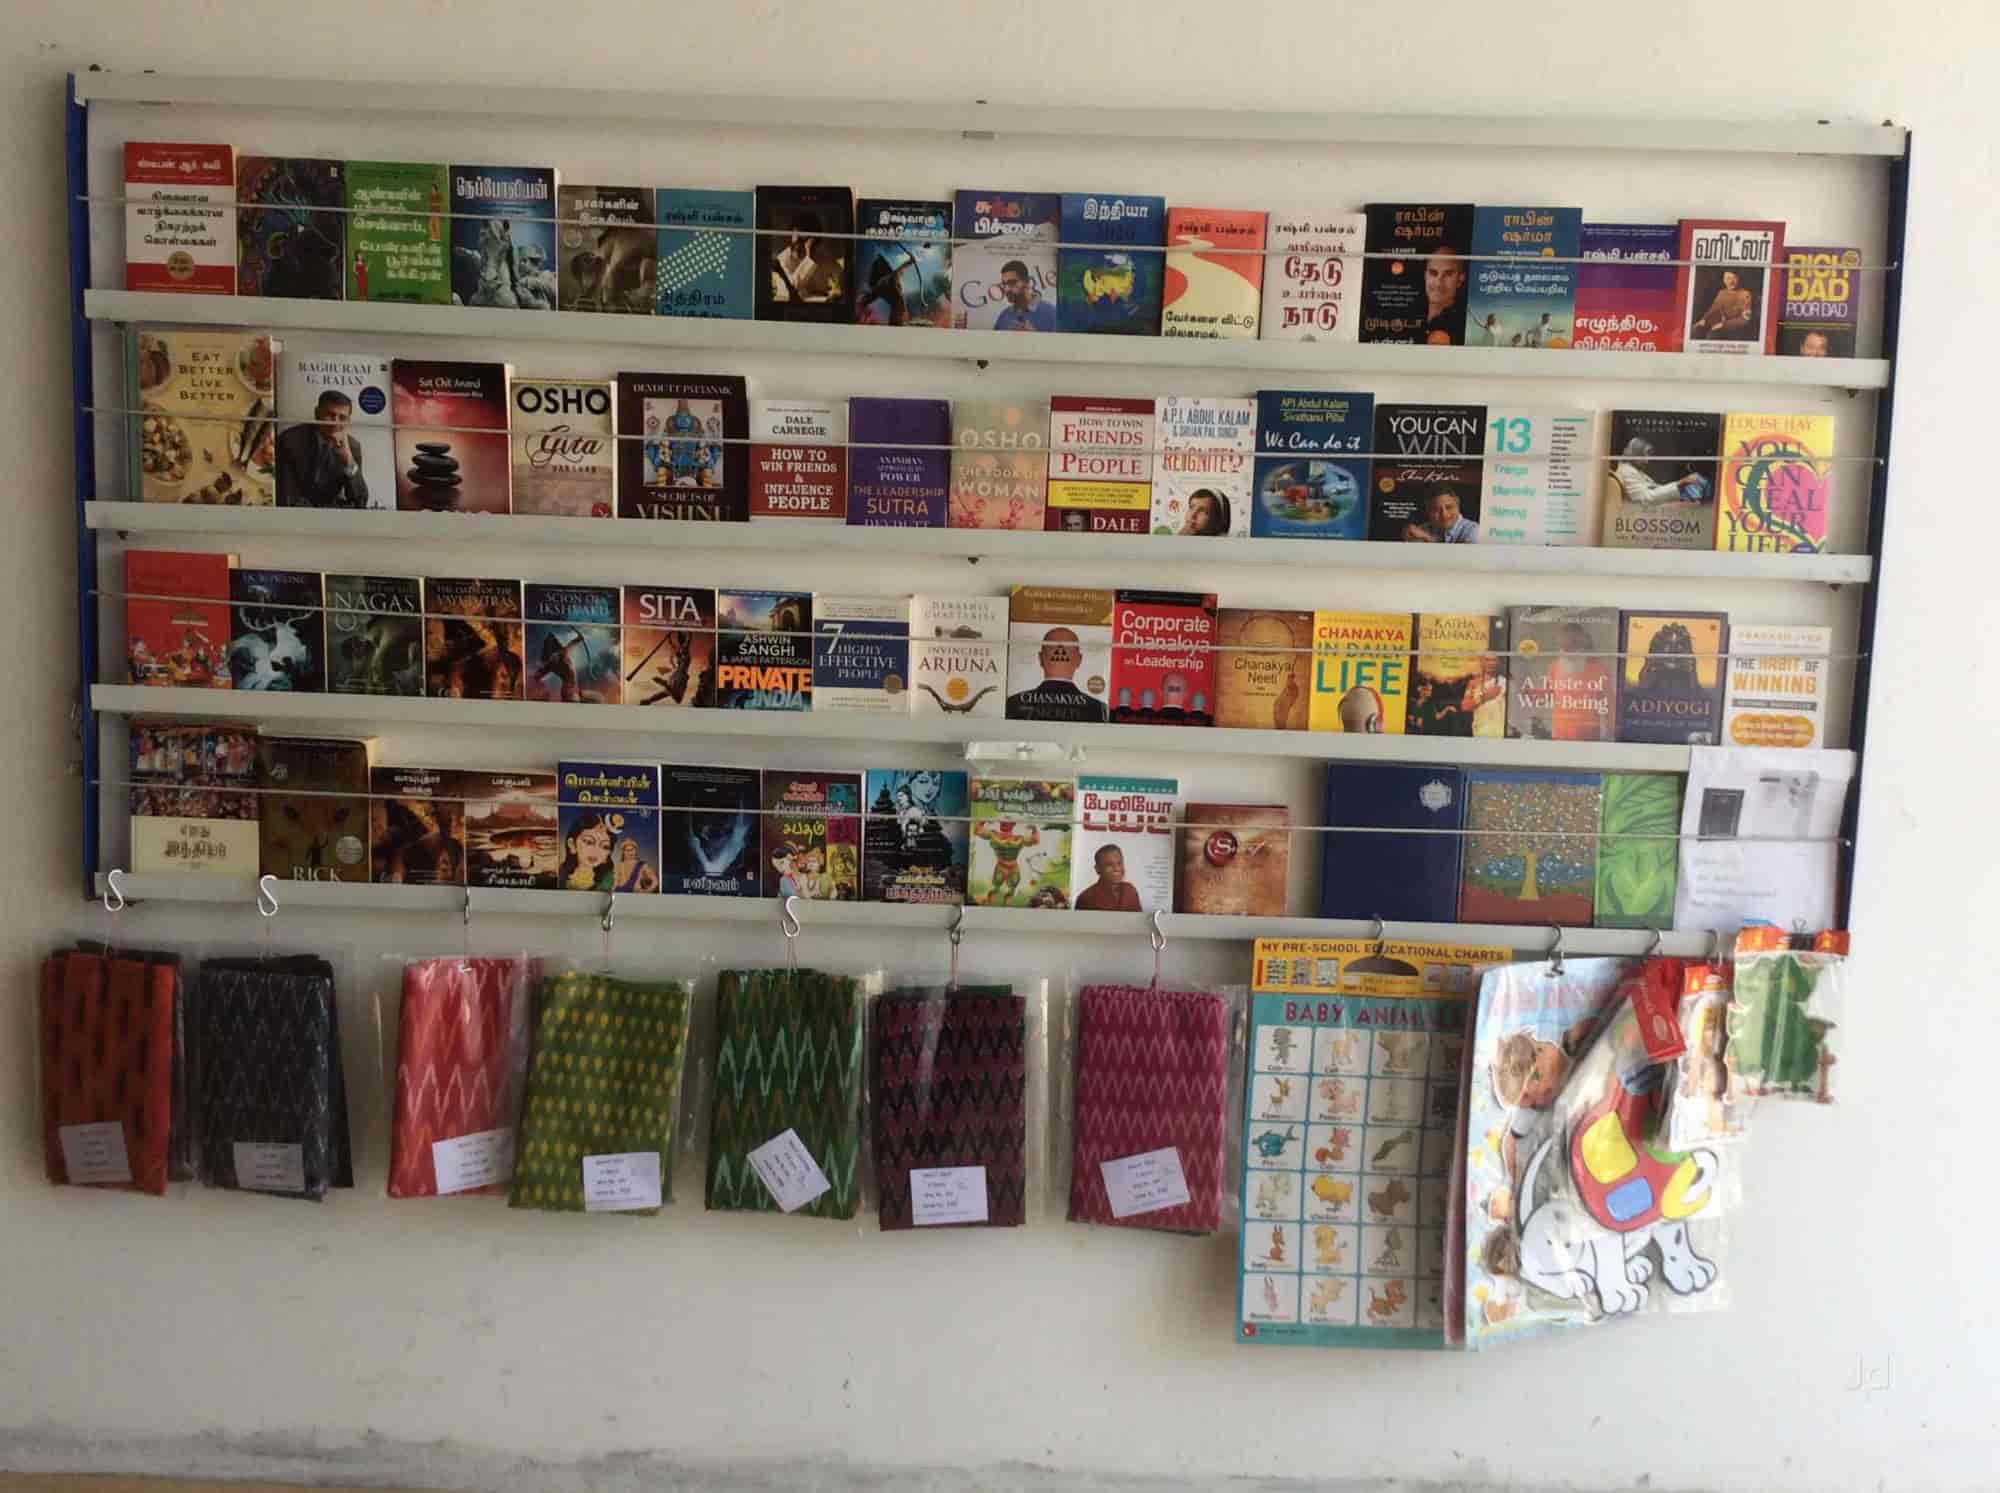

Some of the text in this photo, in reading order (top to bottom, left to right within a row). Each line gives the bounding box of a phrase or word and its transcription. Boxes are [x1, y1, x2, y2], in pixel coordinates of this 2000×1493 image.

[1083, 198, 1150, 220] இந்தியா
[1695, 231, 1771, 263] ஹிட்லர்
[1284, 255, 1344, 287] தேடு
[1788, 254, 1850, 278] RICH
[1787, 278, 1849, 302] DAD
[1282, 302, 1338, 331] நாடு
[1786, 302, 1849, 318] POOR DAD
[179, 364, 234, 375] BETTER
[298, 360, 373, 376] RAGHURAM
[322, 374, 364, 387] RAJAN
[179, 390, 235, 401] BETTER
[517, 386, 611, 415] OSHO
[785, 415, 814, 426] DALE
[1106, 418, 1121, 427] TO
[1124, 419, 1143, 428] WIN
[1187, 408, 1216, 424] ABDUL
[1218, 410, 1250, 426] KALAM
[1390, 416, 1478, 435] YOU CAN
[772, 426, 827, 437] CARNEGIE
[959, 429, 1041, 449] OSHO
[1063, 424, 1143, 445] FRIENDS
[1265, 431, 1361, 450] We Can do it
[1489, 417, 1533, 453] 13
[525, 425, 604, 469] Gita
[771, 449, 827, 461] HOW TO
[1397, 434, 1467, 461] WIN
[761, 461, 837, 473] WIN FRIENDS
[1062, 453, 1142, 475] PEOPLE
[764, 484, 834, 496] INFLUENCE
[875, 486, 945, 496] LEADERSHIP
[959, 480, 1040, 497] WOMAN
[768, 496, 830, 510] PEOPLE
[867, 498, 929, 515] SUTRA
[1094, 517, 1140, 531] DALE
[1615, 517, 1701, 535] BLOSSOM
[1728, 534, 1792, 553] LIFE
[335, 592, 415, 612] NAGAS
[640, 594, 701, 621] SITA
[1122, 610, 1210, 634] Corporate
[744, 634, 791, 645] ASHWIN
[822, 623, 844, 654] 7
[1318, 627, 1405, 641] CHANAKYA
[739, 644, 795, 657] SANGHI
[838, 644, 882, 655] HIGHLY
[1120, 631, 1210, 657] Chanakya
[1315, 642, 1405, 659] IN DAILY
[819, 656, 896, 669] EFFECTIVE
[919, 656, 998, 673] ARJUNA
[1136, 654, 1205, 672] Leadership
[1234, 657, 1292, 673] Chanakya
[1736, 657, 1755, 669] THE
[718, 665, 813, 691] PRIVATE
[838, 668, 880, 680] PEOPLE
[1247, 672, 1278, 685] Neeti
[1316, 660, 1403, 695] LIFE
[1521, 675, 1608, 690] A Taste of
[751, 688, 804, 708] INDIA
[1519, 694, 1609, 713] Well-Being
[1629, 699, 1711, 715] ADIYOGI
[564, 771, 650, 789] பொன்னியின்
[1083, 793, 1173, 813] பேலியோ
[1261, 942, 1504, 961] MY PRE-SCHOOL EDUCATIONAL CHARTS
[1285, 1002, 1346, 1023] BABY
